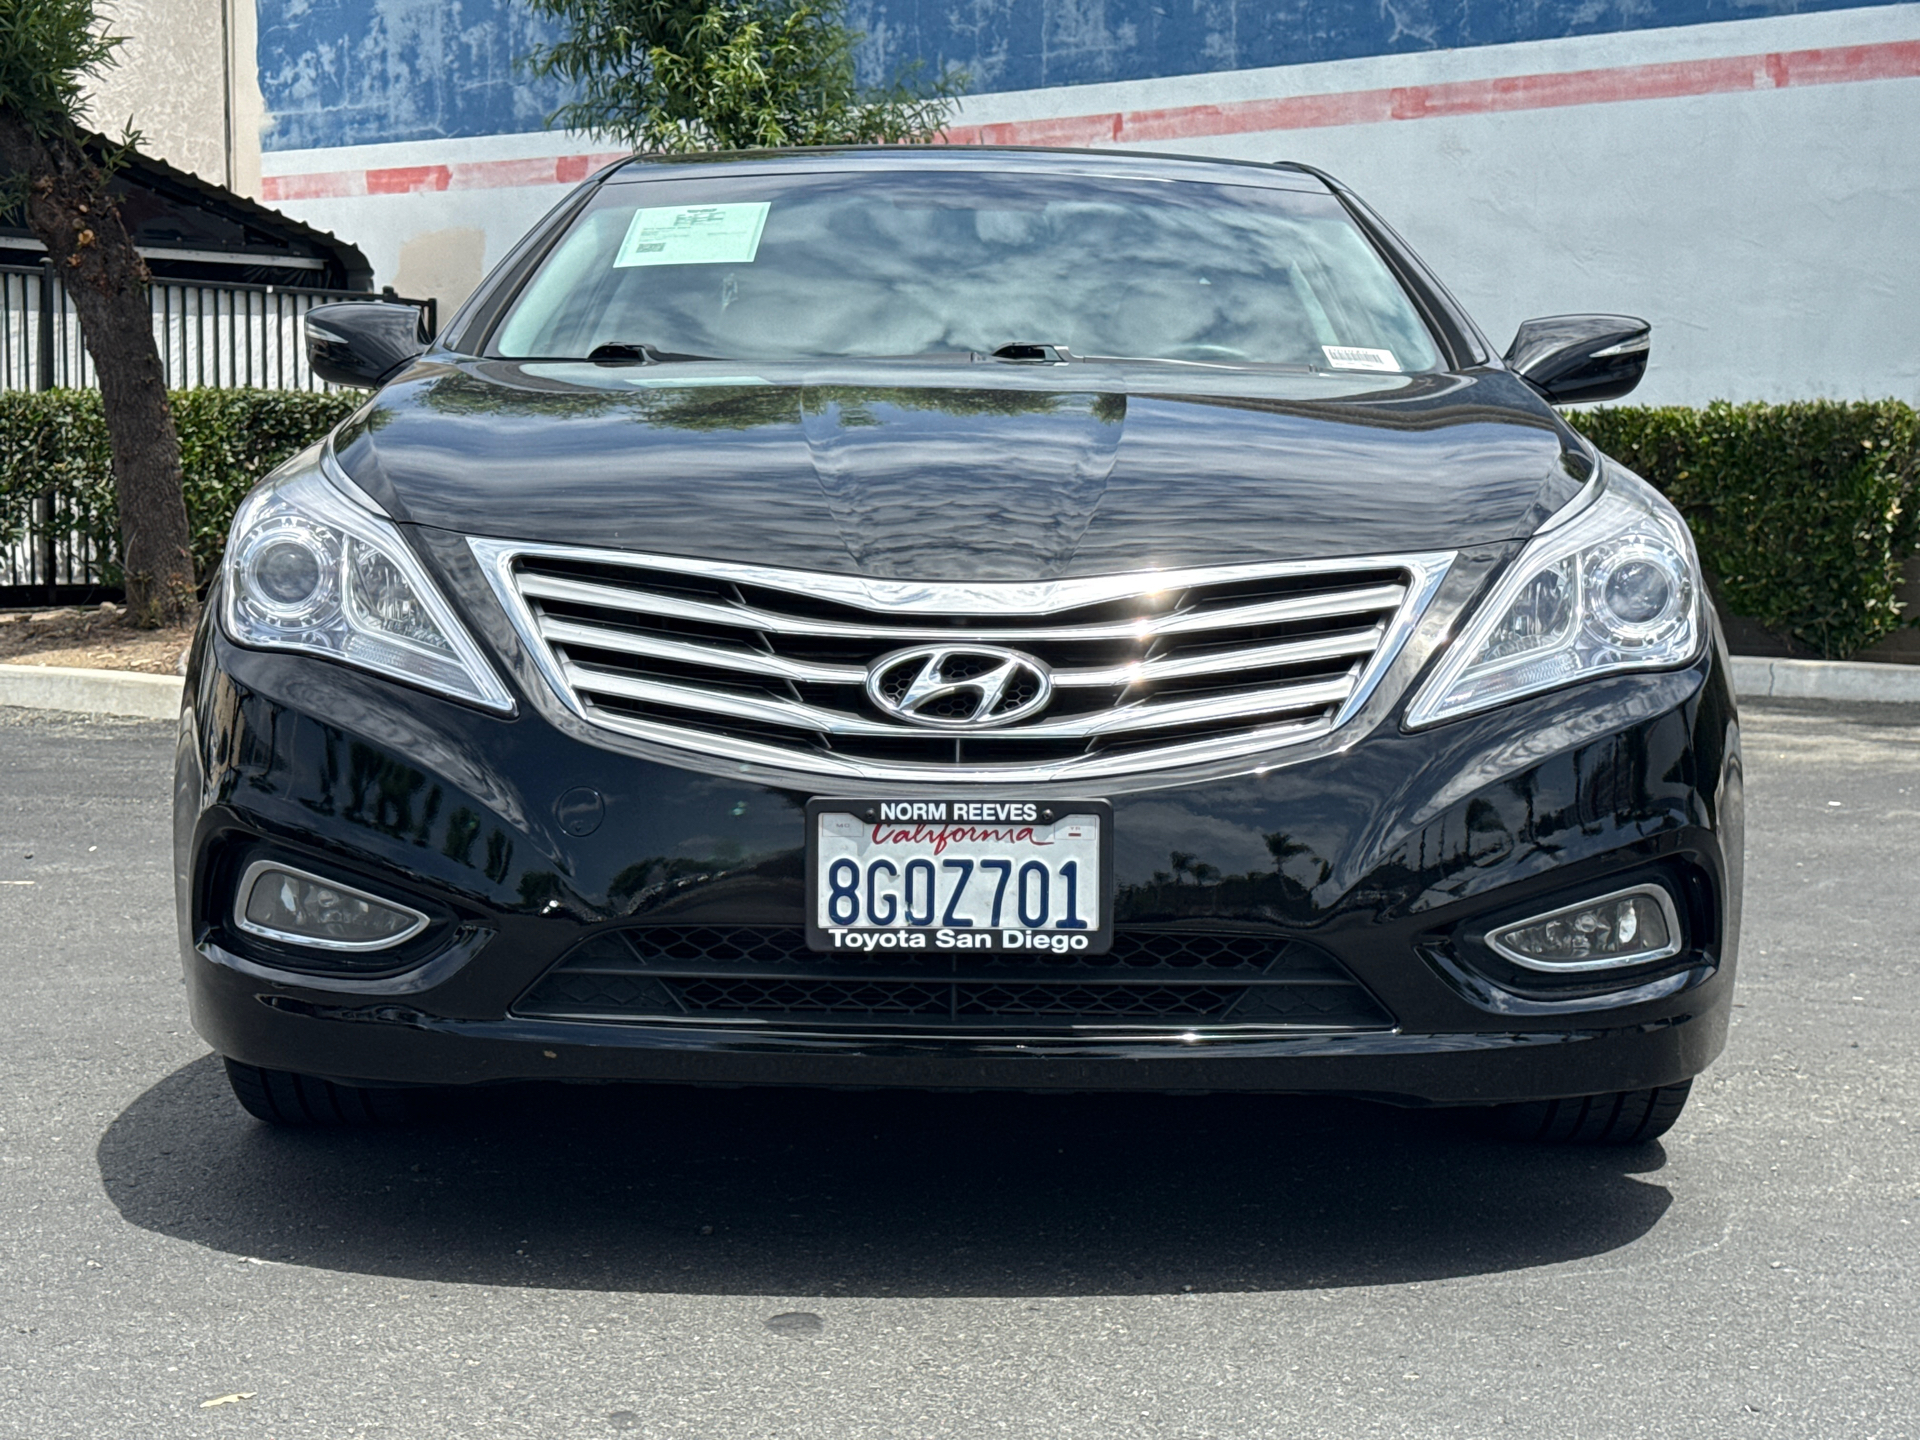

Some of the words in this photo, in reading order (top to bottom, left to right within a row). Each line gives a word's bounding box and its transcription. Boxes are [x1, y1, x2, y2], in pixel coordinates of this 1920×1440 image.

[880, 802, 947, 821] NORM
[953, 803, 1037, 822] REEVES
[871, 823, 1055, 856] California
[828, 928, 926, 951] Toyota
[935, 929, 992, 949] San
[1002, 929, 1089, 954] Diego
